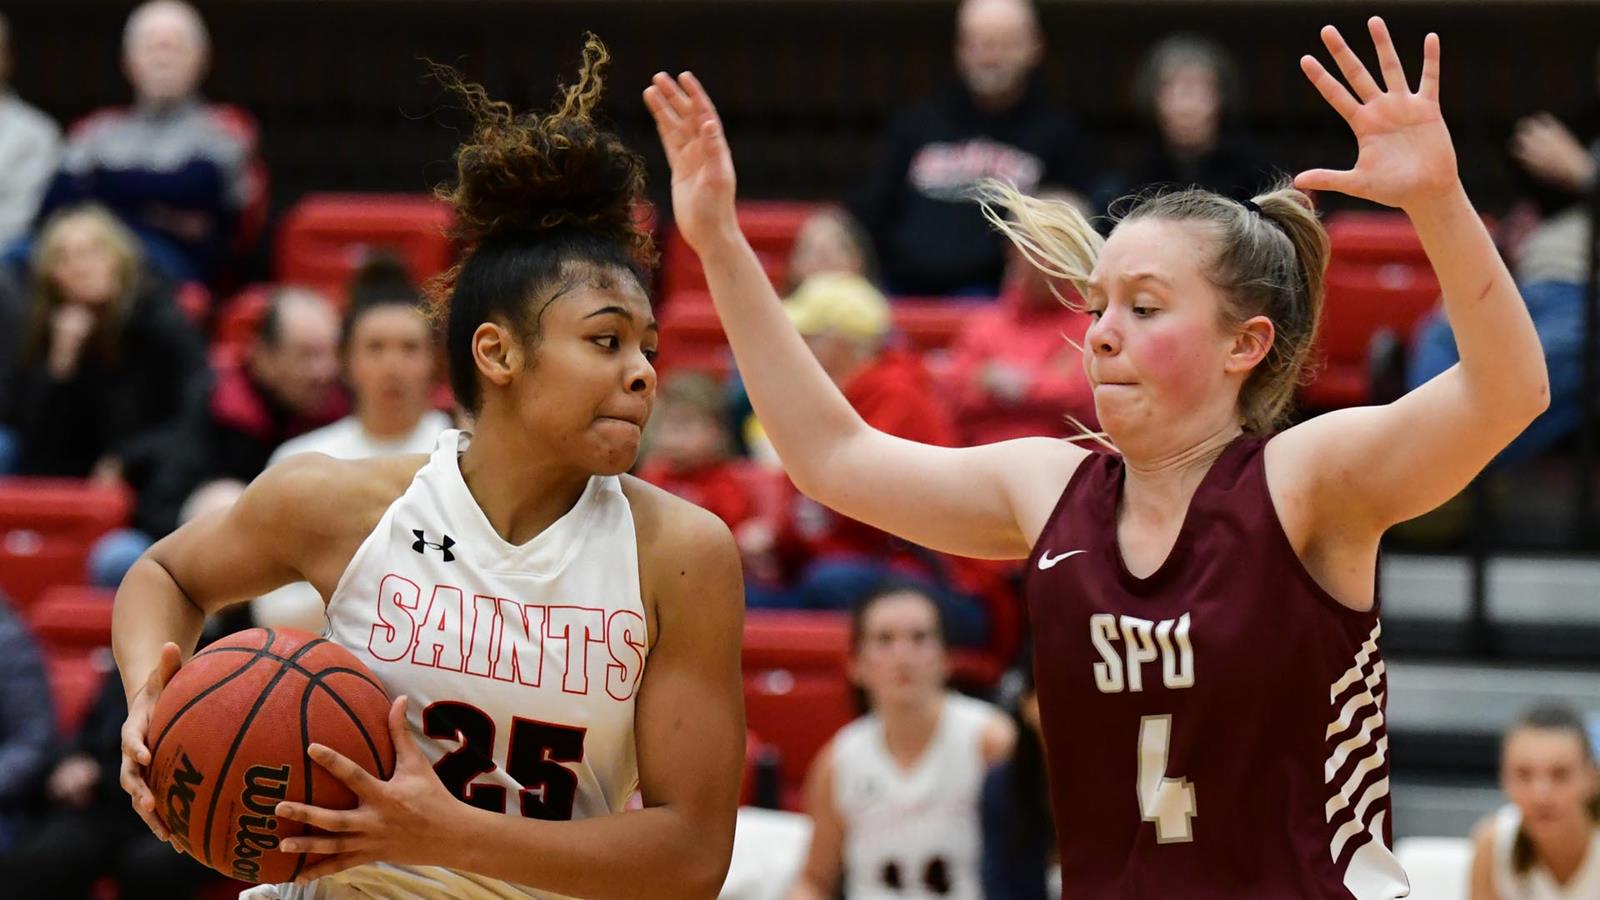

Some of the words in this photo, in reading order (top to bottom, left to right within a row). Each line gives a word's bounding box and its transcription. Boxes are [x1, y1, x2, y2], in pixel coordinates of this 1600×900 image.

[368, 574, 646, 701] SAINTS
[1089, 611, 1195, 693] SPU
[423, 700, 587, 821] 25
[1137, 713, 1198, 844] 4
